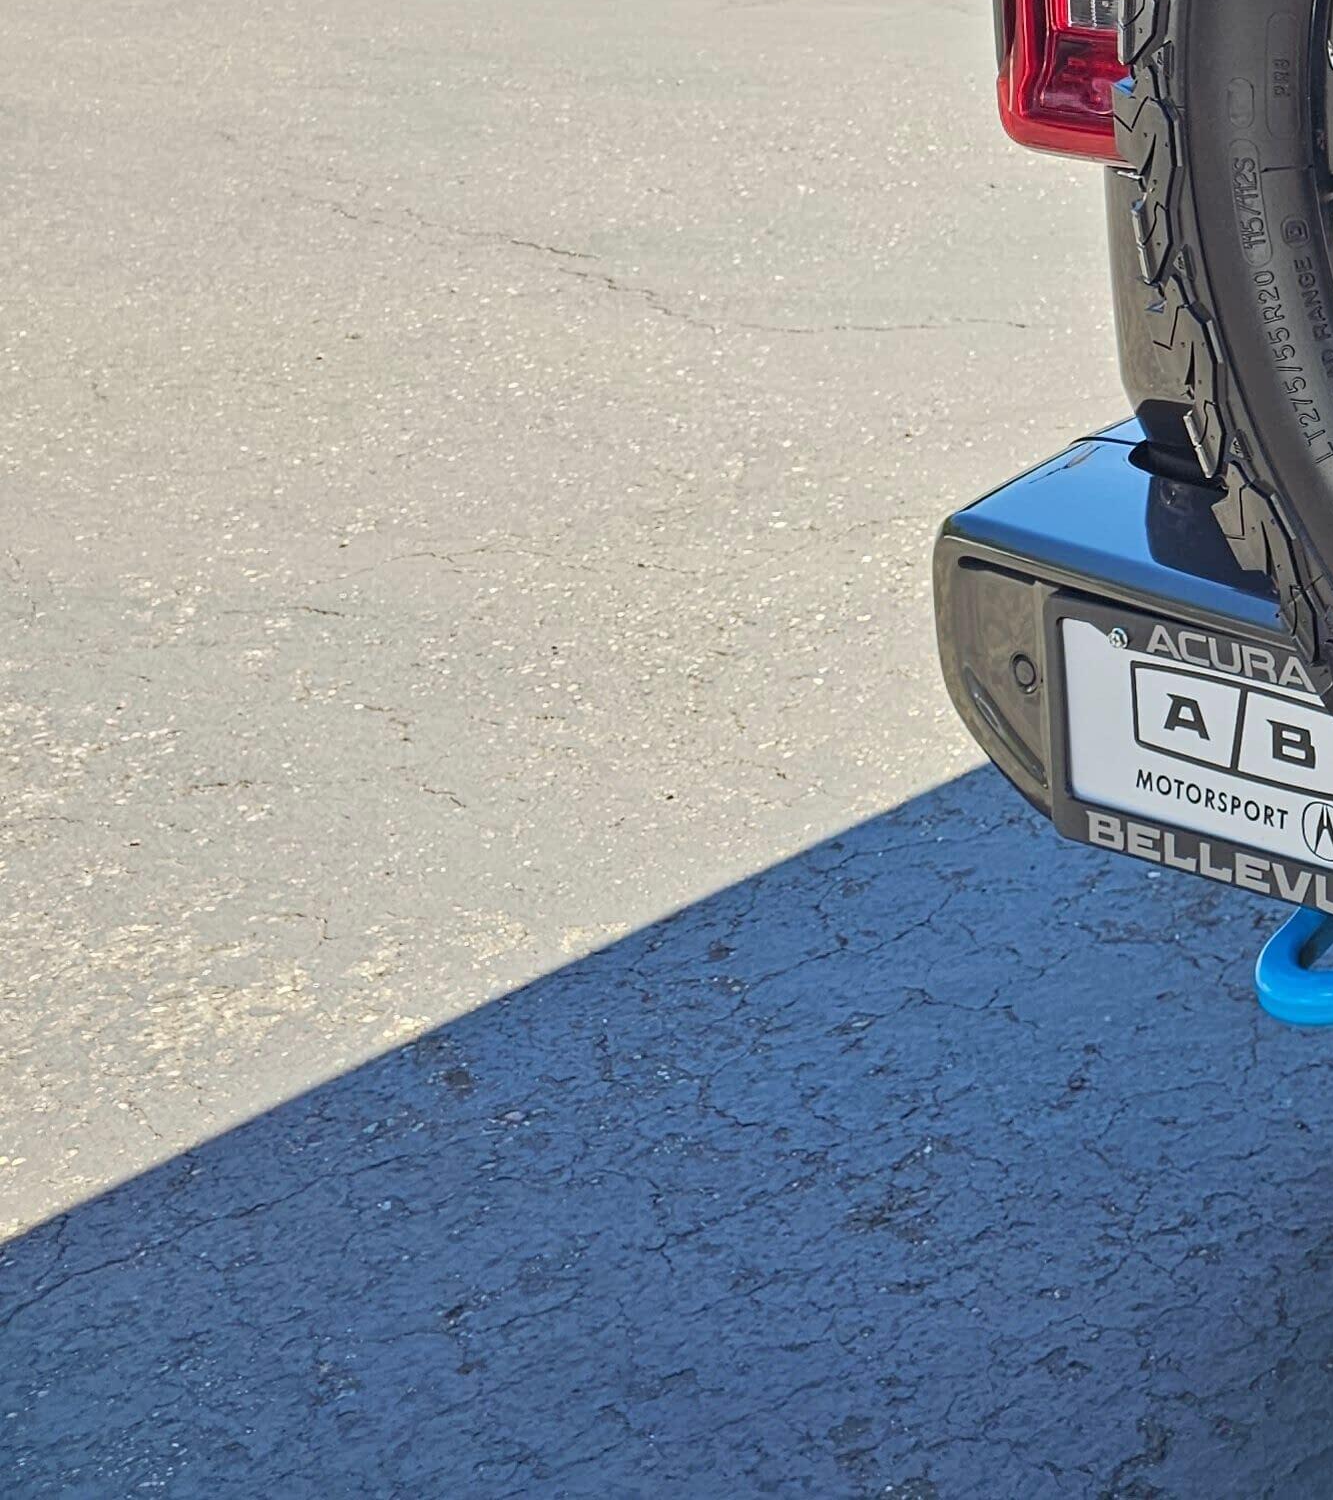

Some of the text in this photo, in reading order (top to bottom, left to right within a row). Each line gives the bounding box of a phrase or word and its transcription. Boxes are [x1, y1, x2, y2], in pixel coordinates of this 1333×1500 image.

[1292, 254, 1332, 342] RANGE
[1146, 625, 1316, 692] ACURA
[1163, 693, 1316, 769] A B
[1135, 769, 1289, 830] MOTORSPORT
